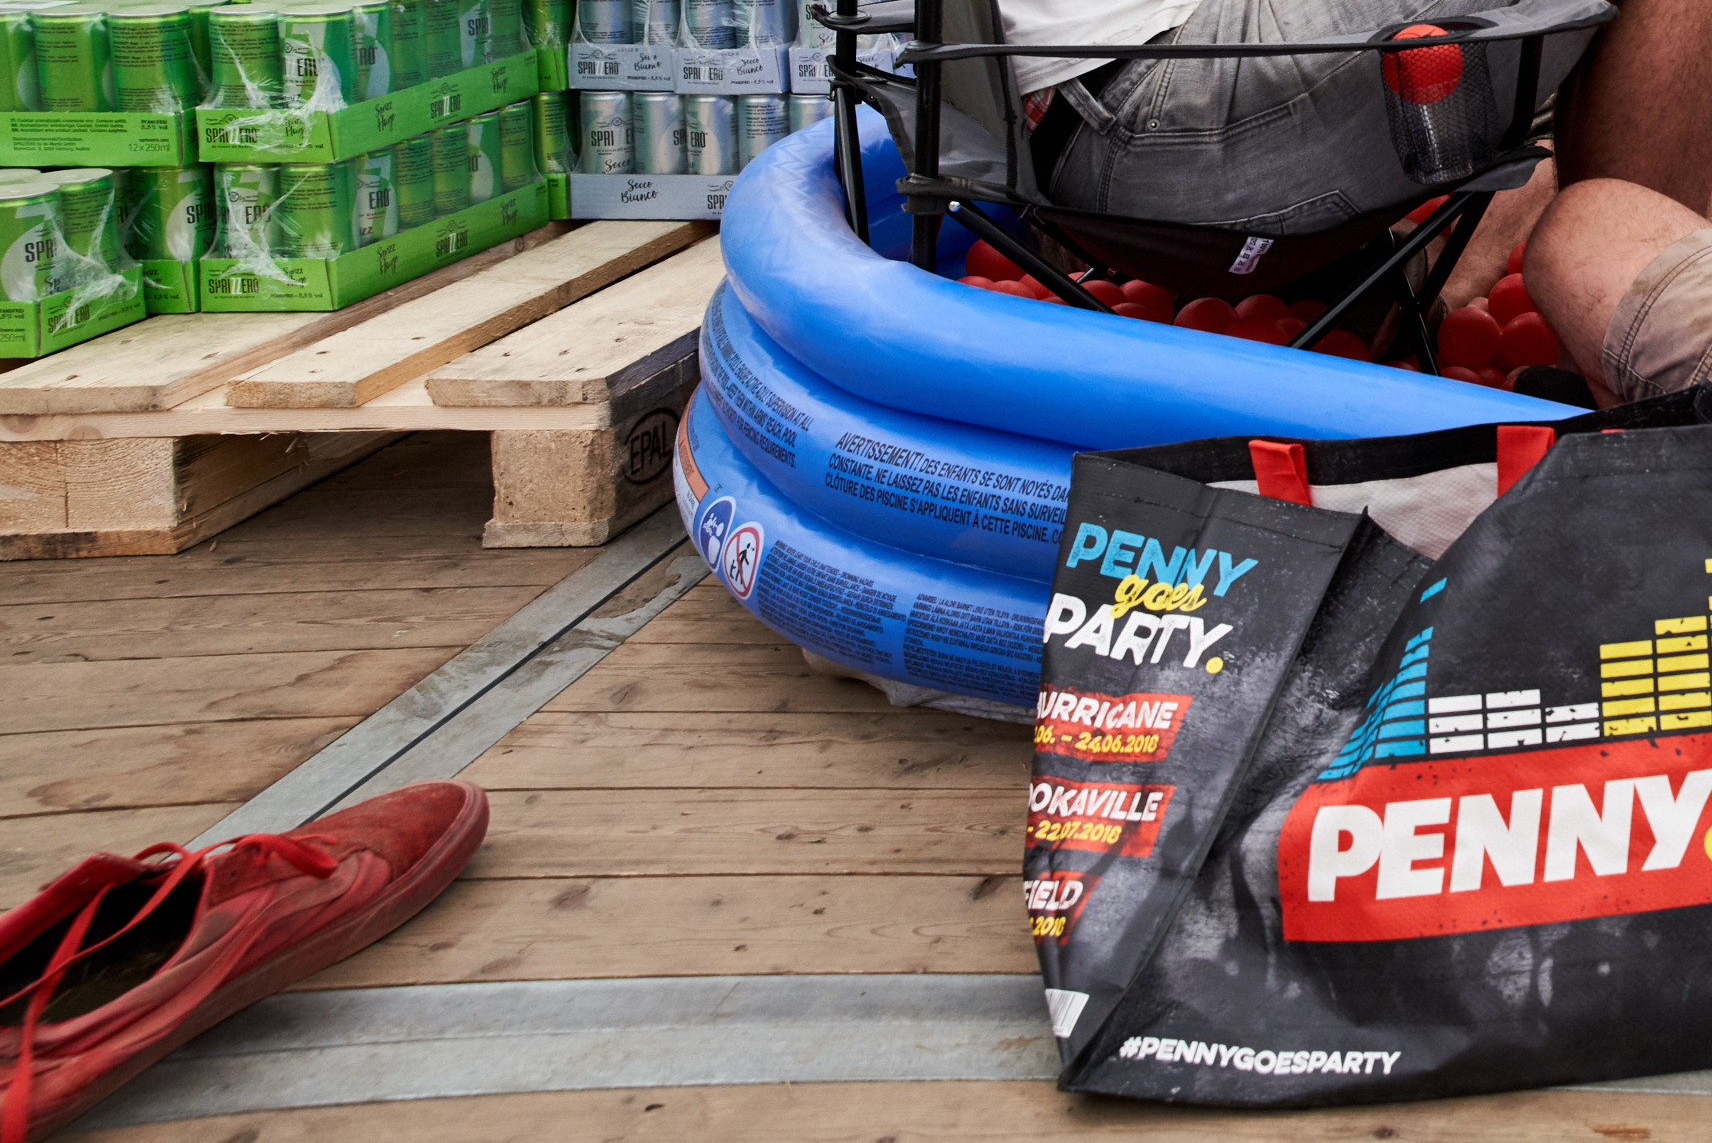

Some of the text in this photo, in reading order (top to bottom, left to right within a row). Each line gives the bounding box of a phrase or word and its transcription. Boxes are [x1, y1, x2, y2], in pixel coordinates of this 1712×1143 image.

[620, 189, 658, 204] Bianco
[627, 179, 654, 193] Secco
[629, 420, 675, 475] EPAL
[781, 427, 798, 448] POOL
[835, 431, 925, 471] AVERTISSEMENT!
[918, 458, 940, 476] DES
[938, 462, 981, 485] ENFANTS
[979, 470, 994, 488] SE
[992, 473, 1021, 493] SONT
[1019, 479, 1054, 500] NOYÉS
[825, 471, 859, 498] CLÔTURE
[859, 482, 877, 501] DES
[876, 486, 910, 511] PISCINE
[909, 495, 973, 528] S'APPLIQUENT
[971, 510, 981, 529] À
[981, 515, 1012, 536] CETTE
[1011, 520, 1050, 543] PISCINE.
[828, 452, 1069, 526] CONSTANTE. NE LAISSEZ PAS LES ENFANTS SANS SURVEIL
[1066, 521, 1259, 599] PENNY
[1110, 573, 1208, 619] goes
[1042, 591, 1235, 675] PARTY.
[1029, 783, 1163, 822] OKAVILLE
[1023, 879, 1084, 911] FIELD
[1119, 1034, 1401, 1078] #PENNYGOESPARTY
